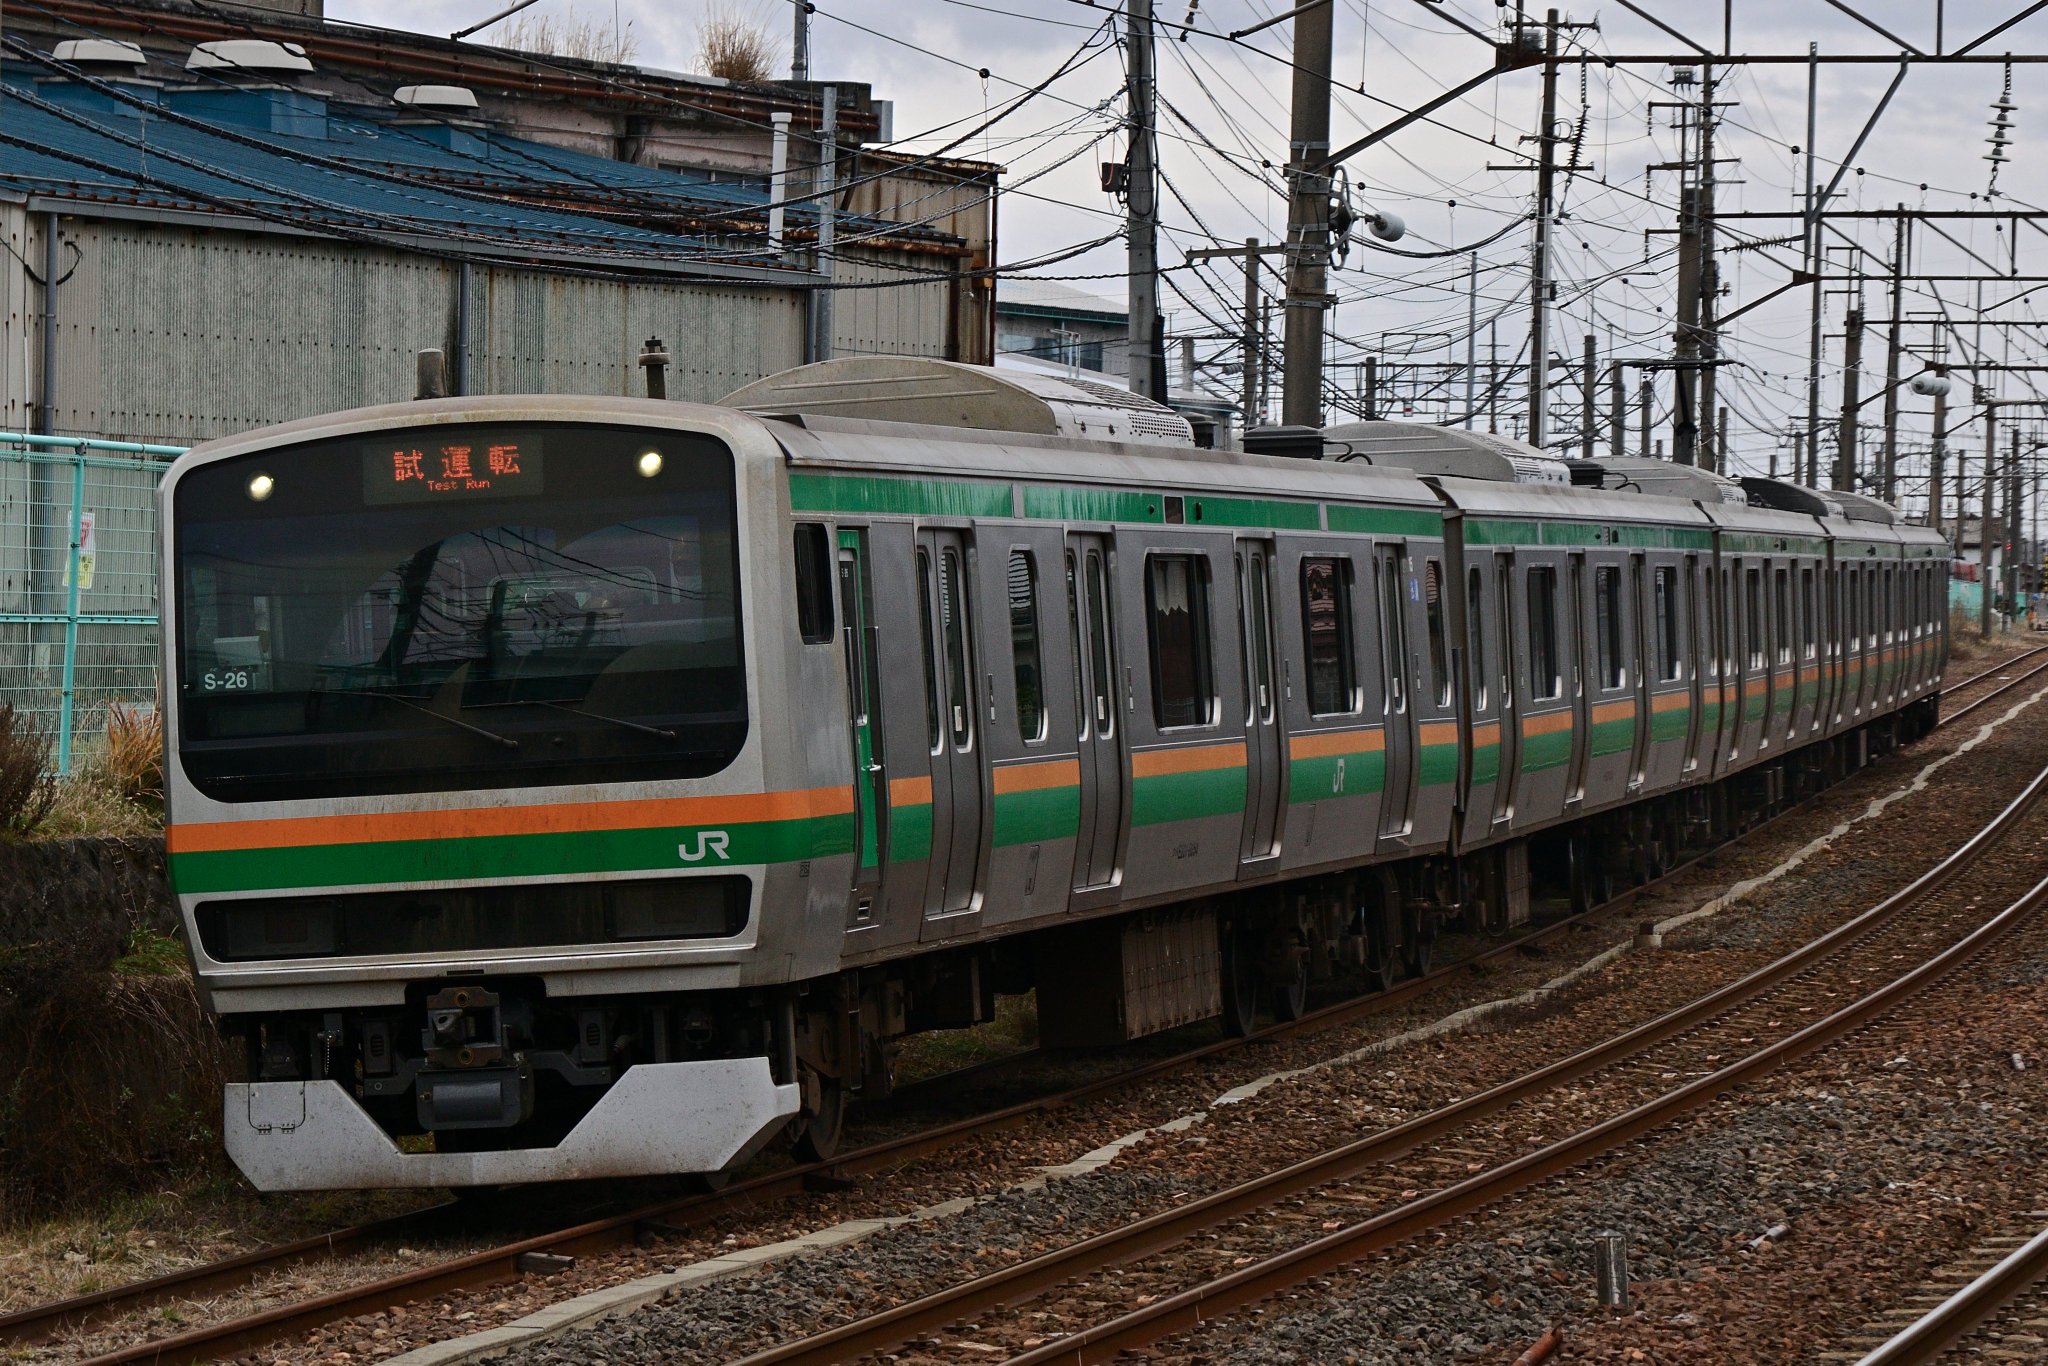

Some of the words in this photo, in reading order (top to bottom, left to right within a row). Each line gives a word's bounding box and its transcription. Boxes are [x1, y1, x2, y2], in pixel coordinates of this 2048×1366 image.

[393, 445, 521, 481] 試運転
[427, 480, 458, 492] Test
[465, 478, 491, 490] Run
[204, 671, 248, 690] S-26
[1333, 758, 1345, 793] JR
[678, 830, 730, 861] JR
